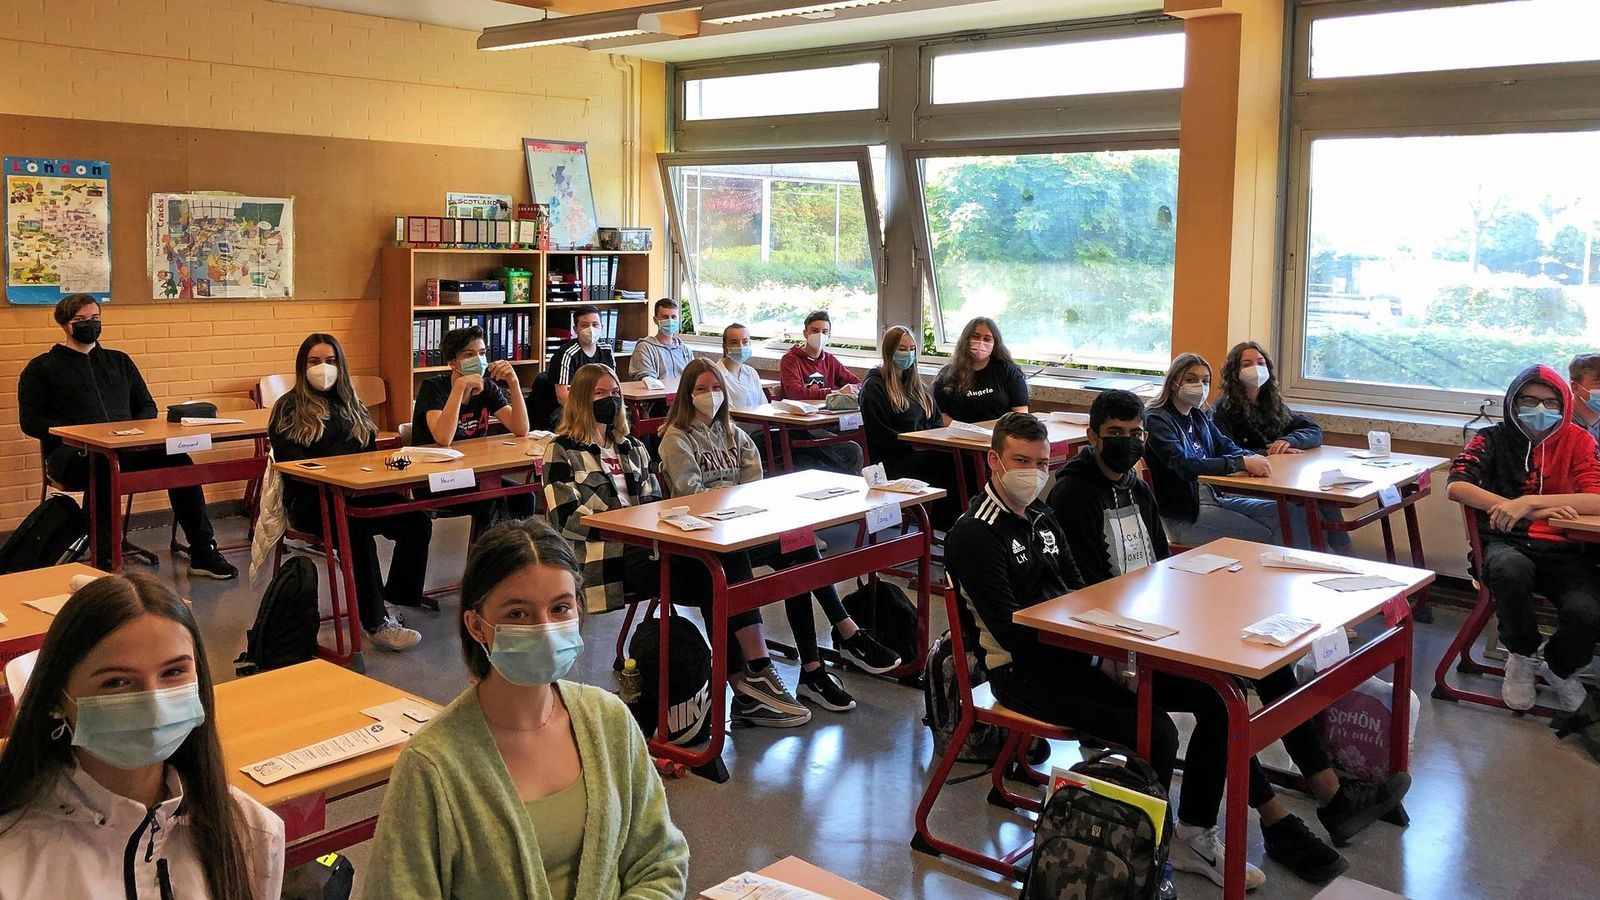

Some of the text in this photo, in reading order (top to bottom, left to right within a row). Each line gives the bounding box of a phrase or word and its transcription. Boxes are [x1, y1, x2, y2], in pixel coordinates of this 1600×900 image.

[11, 160, 102, 176] London
[457, 198, 498, 206] SCOTLAND
[156, 198, 164, 228] Cracks
[1127, 551, 1144, 562] ONES
[667, 680, 710, 734] NIKE
[1328, 707, 1381, 733] SCHÖN
